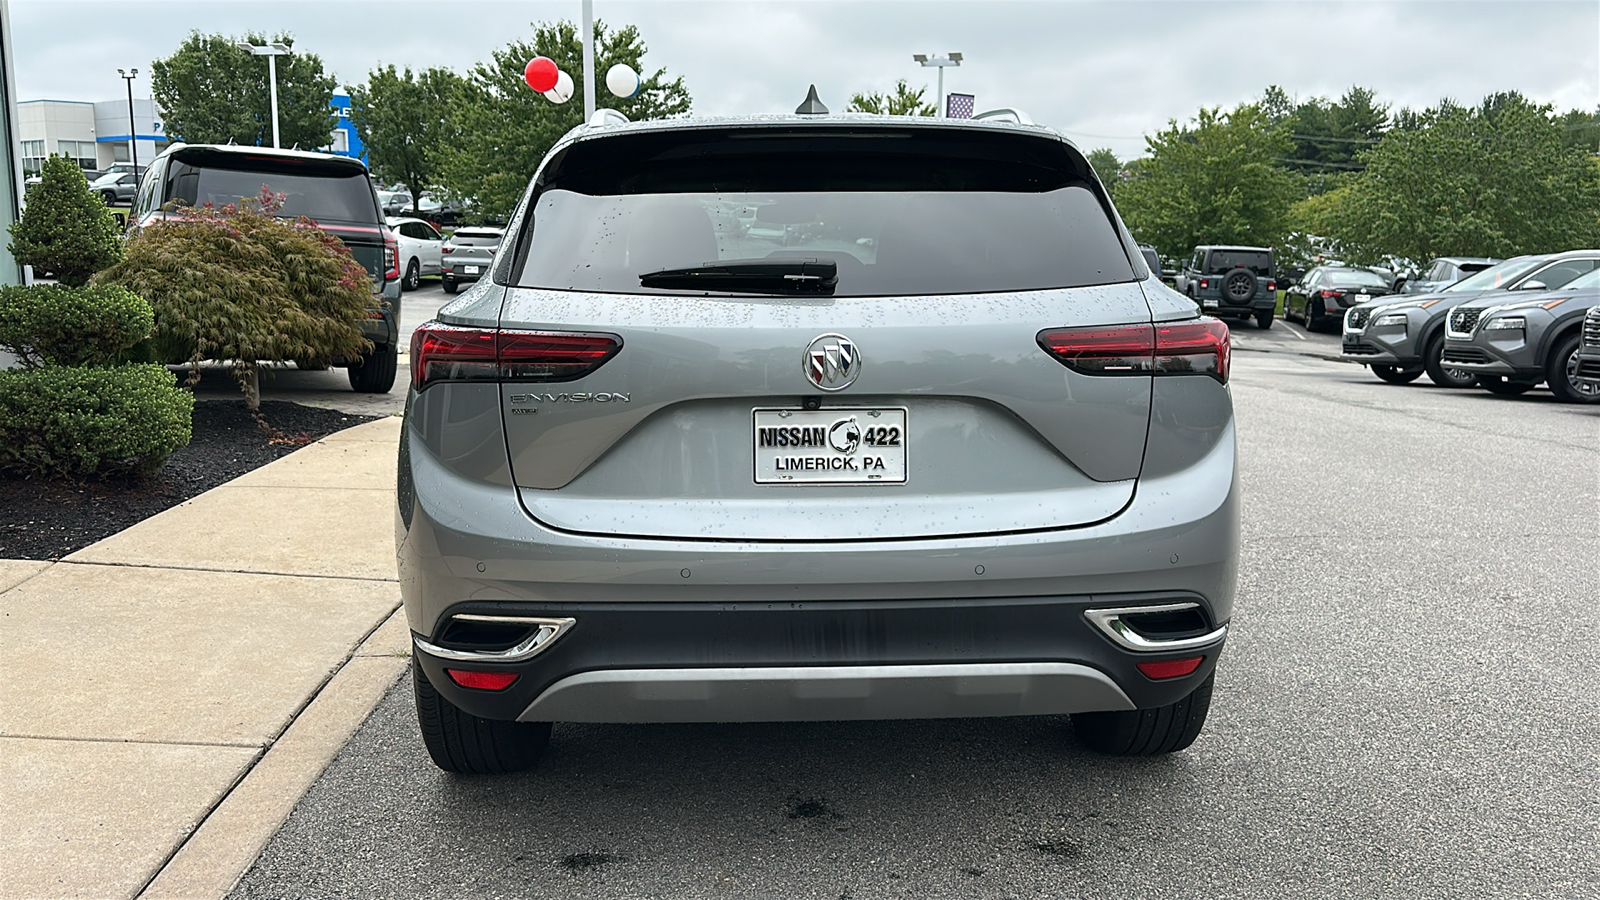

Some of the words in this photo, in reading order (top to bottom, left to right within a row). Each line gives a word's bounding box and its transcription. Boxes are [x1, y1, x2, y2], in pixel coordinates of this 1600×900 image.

[510, 392, 631, 404] ENVISION
[758, 427, 826, 447] NISSAN
[863, 427, 901, 447] 422
[775, 457, 859, 471] LIMERICK,
[863, 457, 886, 470] PA
